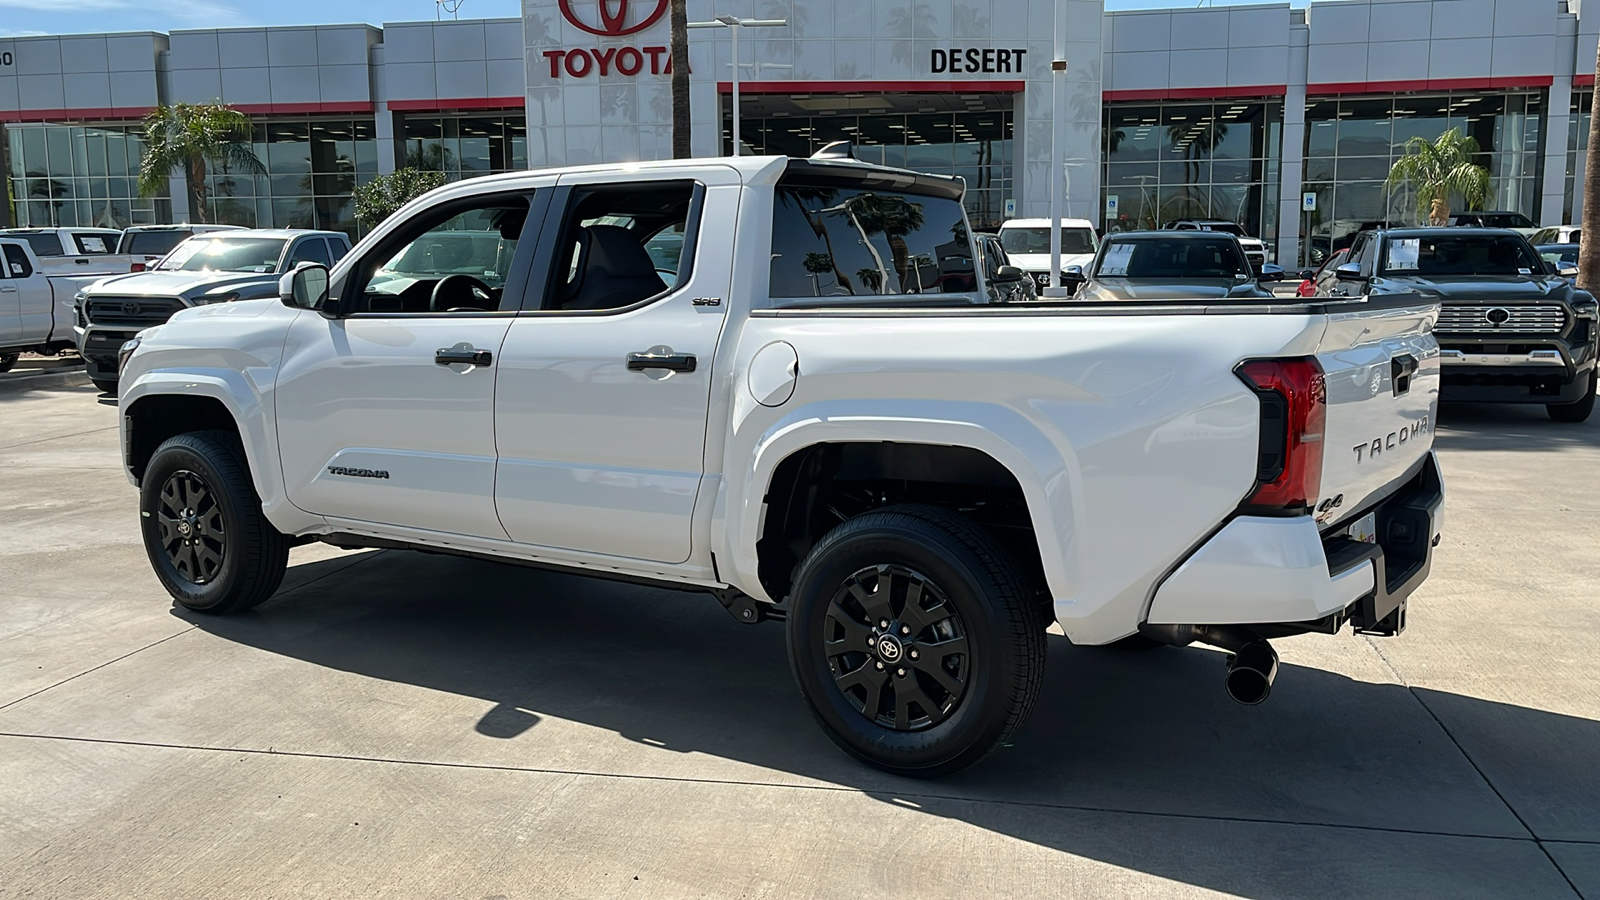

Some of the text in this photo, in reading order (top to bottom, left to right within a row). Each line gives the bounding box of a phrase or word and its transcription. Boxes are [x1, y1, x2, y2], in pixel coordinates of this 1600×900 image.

[931, 48, 1027, 73] DESERT
[1353, 416, 1429, 464] TACOMA
[328, 466, 389, 479] TACOMA
